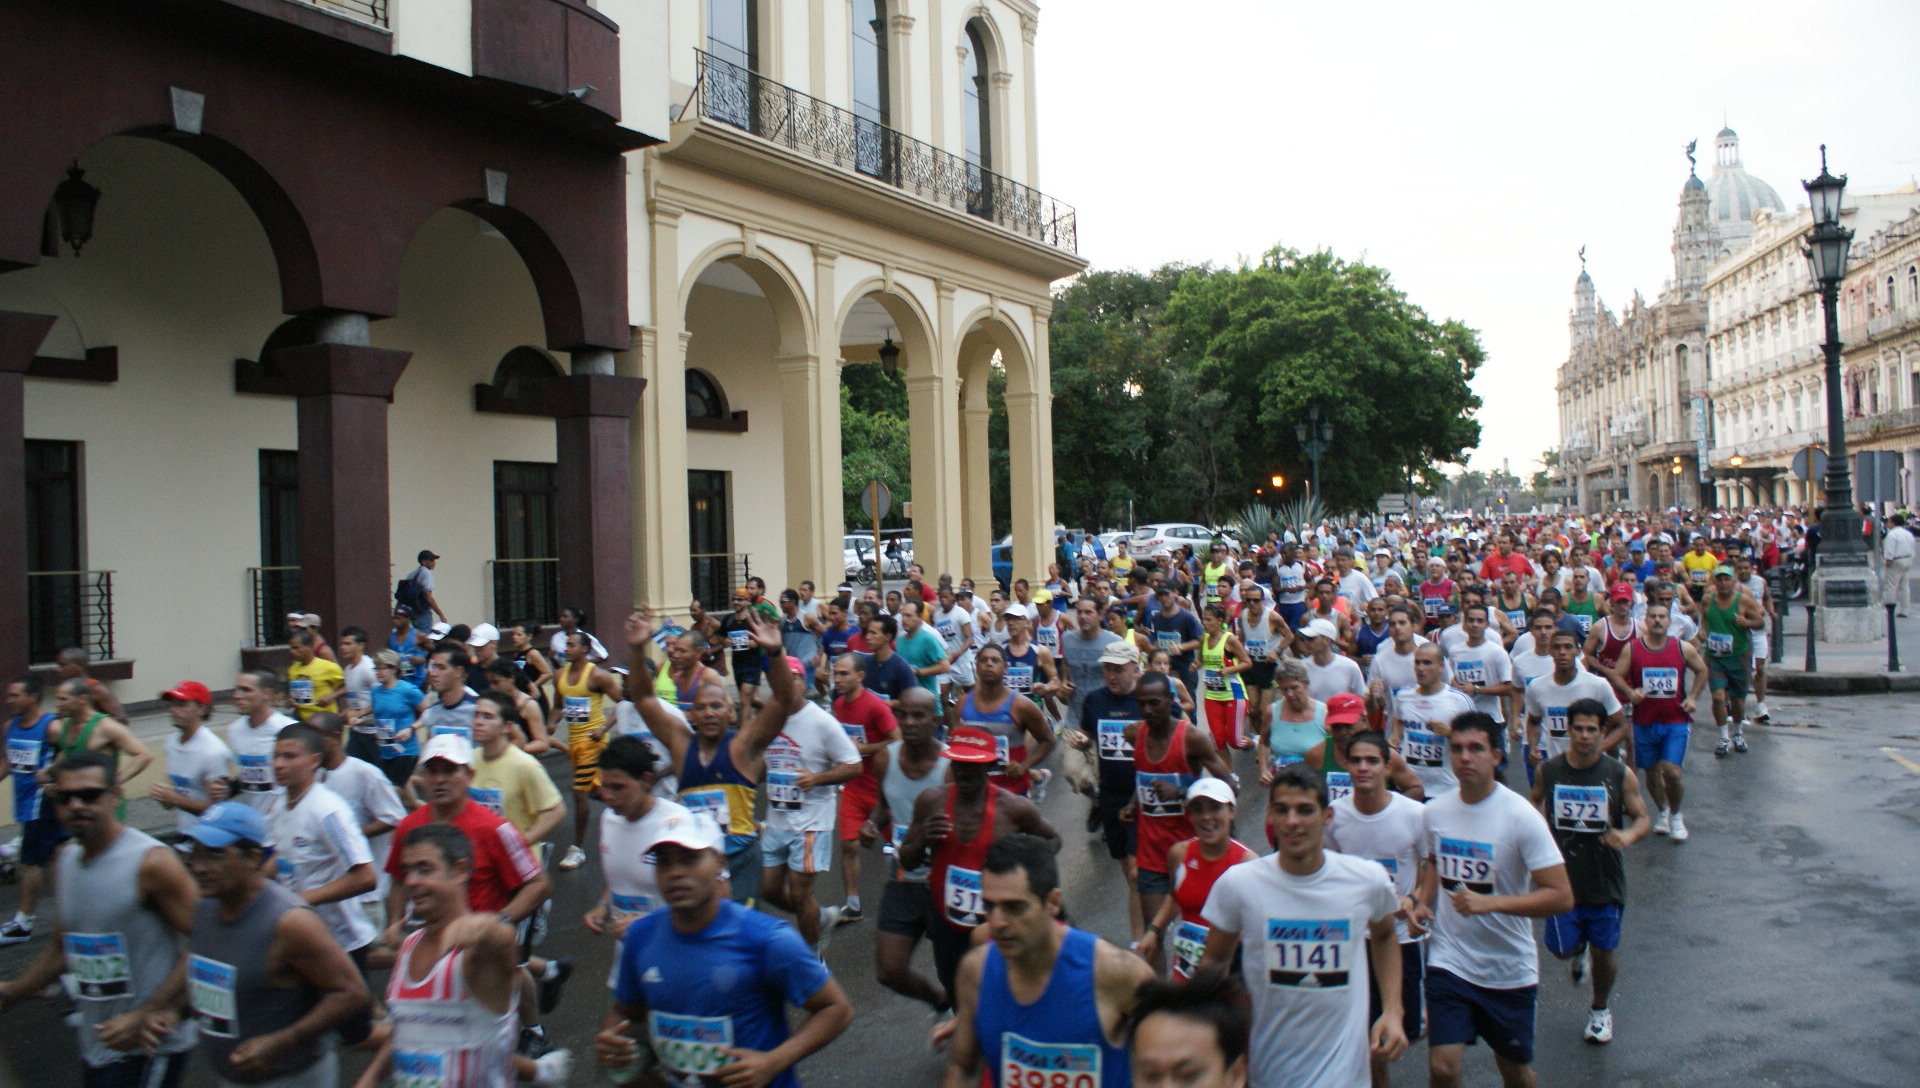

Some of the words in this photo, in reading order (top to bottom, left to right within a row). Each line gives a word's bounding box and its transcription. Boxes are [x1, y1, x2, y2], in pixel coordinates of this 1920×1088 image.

[1648, 678, 1673, 690] 568
[1551, 717, 1565, 729] 11
[1101, 734, 1126, 748] 247
[1407, 743, 1443, 759] 1458
[1562, 802, 1599, 819] 572
[1441, 855, 1490, 880] 1159
[952, 888, 978, 911] 51
[1274, 942, 1341, 969] 1141
